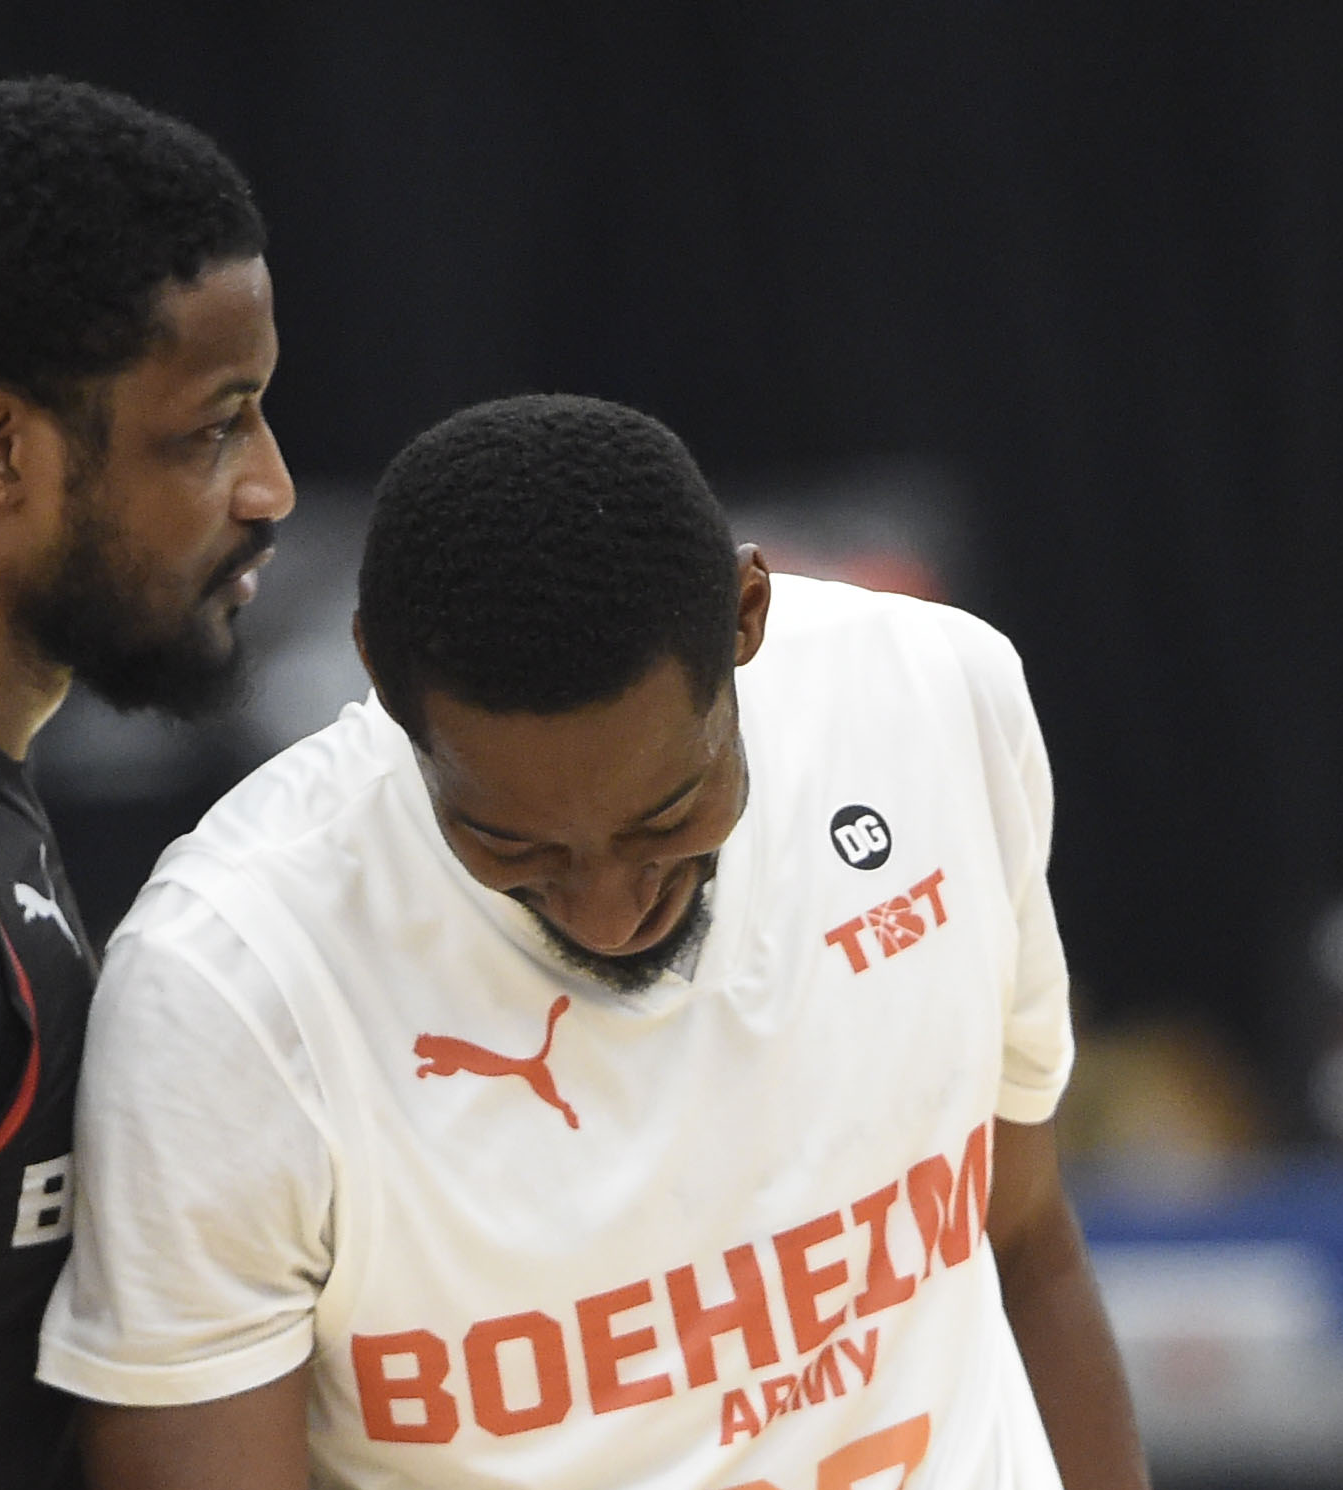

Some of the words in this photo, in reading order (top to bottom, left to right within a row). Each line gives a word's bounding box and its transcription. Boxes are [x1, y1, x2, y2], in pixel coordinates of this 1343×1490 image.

[833, 814, 889, 865] DG
[824, 867, 948, 974] TBT
[350, 1122, 990, 1447] BOEHEIM
[719, 1325, 879, 1446] ARMY
